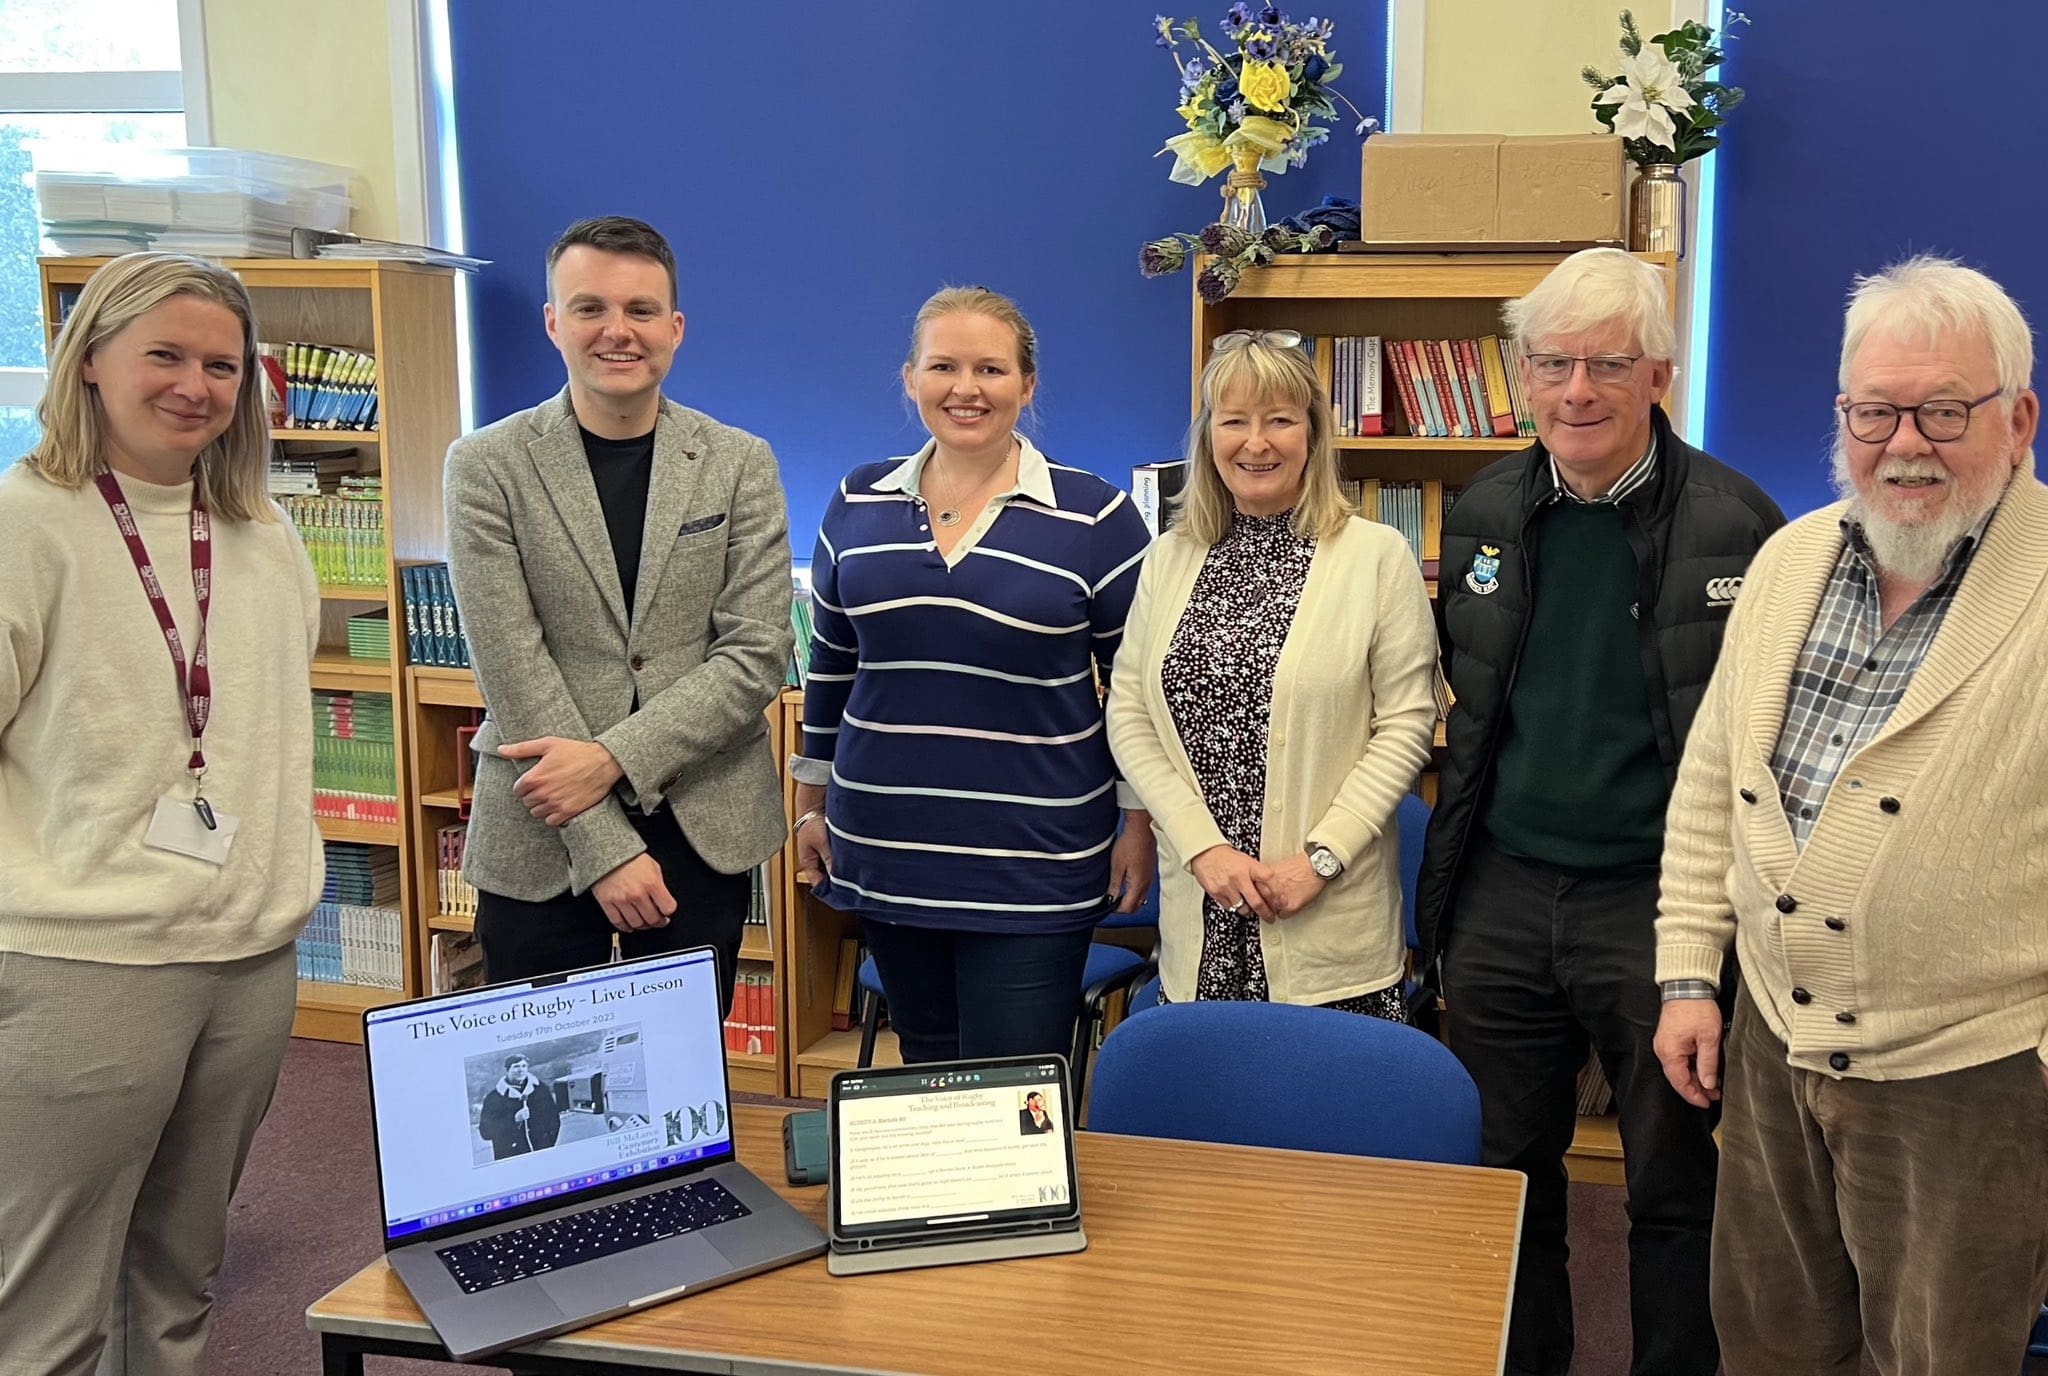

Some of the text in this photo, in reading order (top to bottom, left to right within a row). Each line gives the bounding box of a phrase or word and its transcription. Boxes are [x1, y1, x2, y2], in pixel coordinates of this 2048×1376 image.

[1367, 337, 1378, 412] The Memory Cage
[407, 1022, 446, 1041] The
[448, 1011, 497, 1033] Voice
[500, 1004, 520, 1023] of
[522, 996, 576, 1019] Rugby
[591, 989, 627, 1006] Live
[630, 977, 684, 998] Lesson
[496, 1013, 615, 1044] Tuesday 17th October 2023
[663, 1100, 725, 1147] 100
